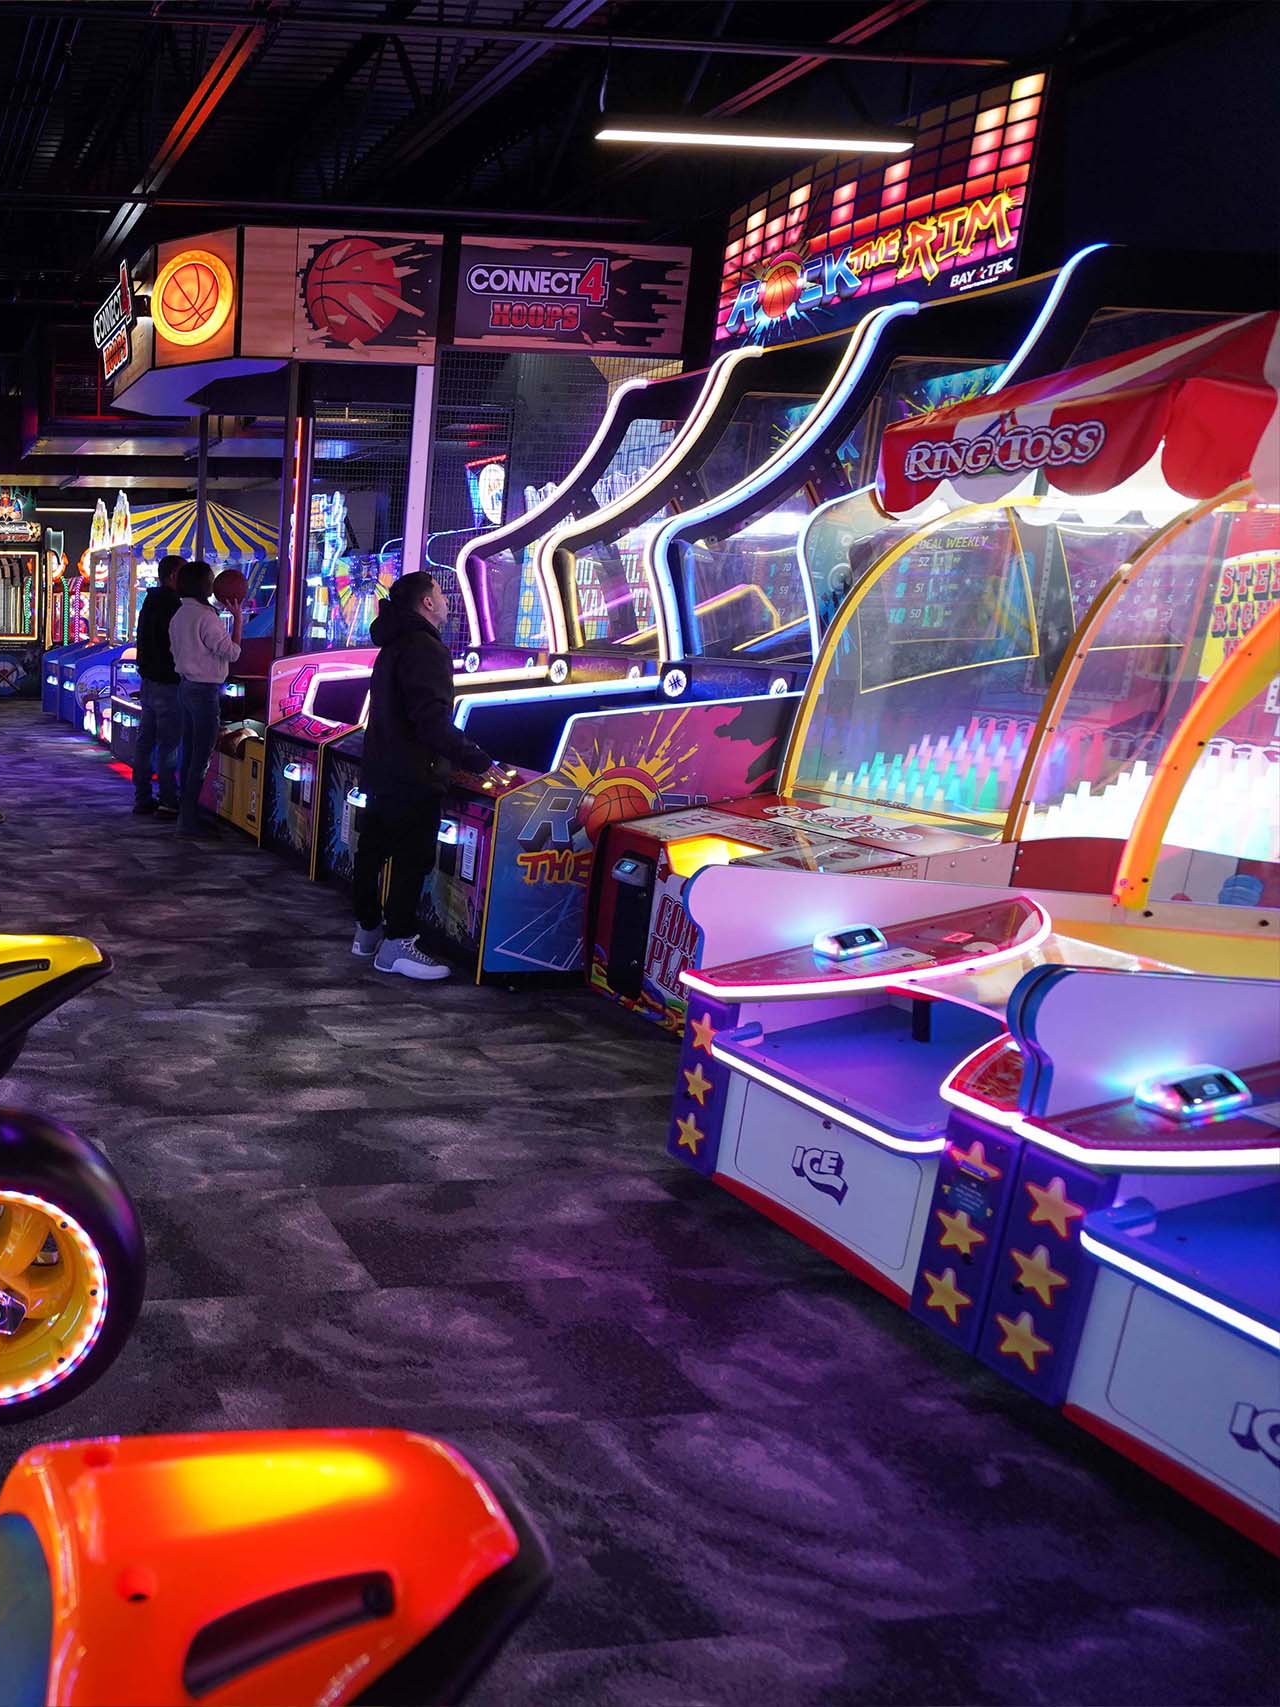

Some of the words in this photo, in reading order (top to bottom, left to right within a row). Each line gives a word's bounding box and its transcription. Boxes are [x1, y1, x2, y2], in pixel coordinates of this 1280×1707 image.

[848, 228, 903, 276] THE
[896, 188, 1016, 286] RIM
[469, 267, 581, 295] CONNECT
[577, 261, 606, 303] 4
[950, 269, 977, 288] BAY
[987, 257, 1014, 276] TEK
[490, 302, 579, 330] HOOPS
[905, 440, 993, 478] RING
[998, 426, 1100, 466] TOSS
[946, 535, 989, 549] WEEKLY
[517, 850, 593, 887] THE
[792, 1145, 848, 1206] ICE
[1228, 1401, 1280, 1470] IC
